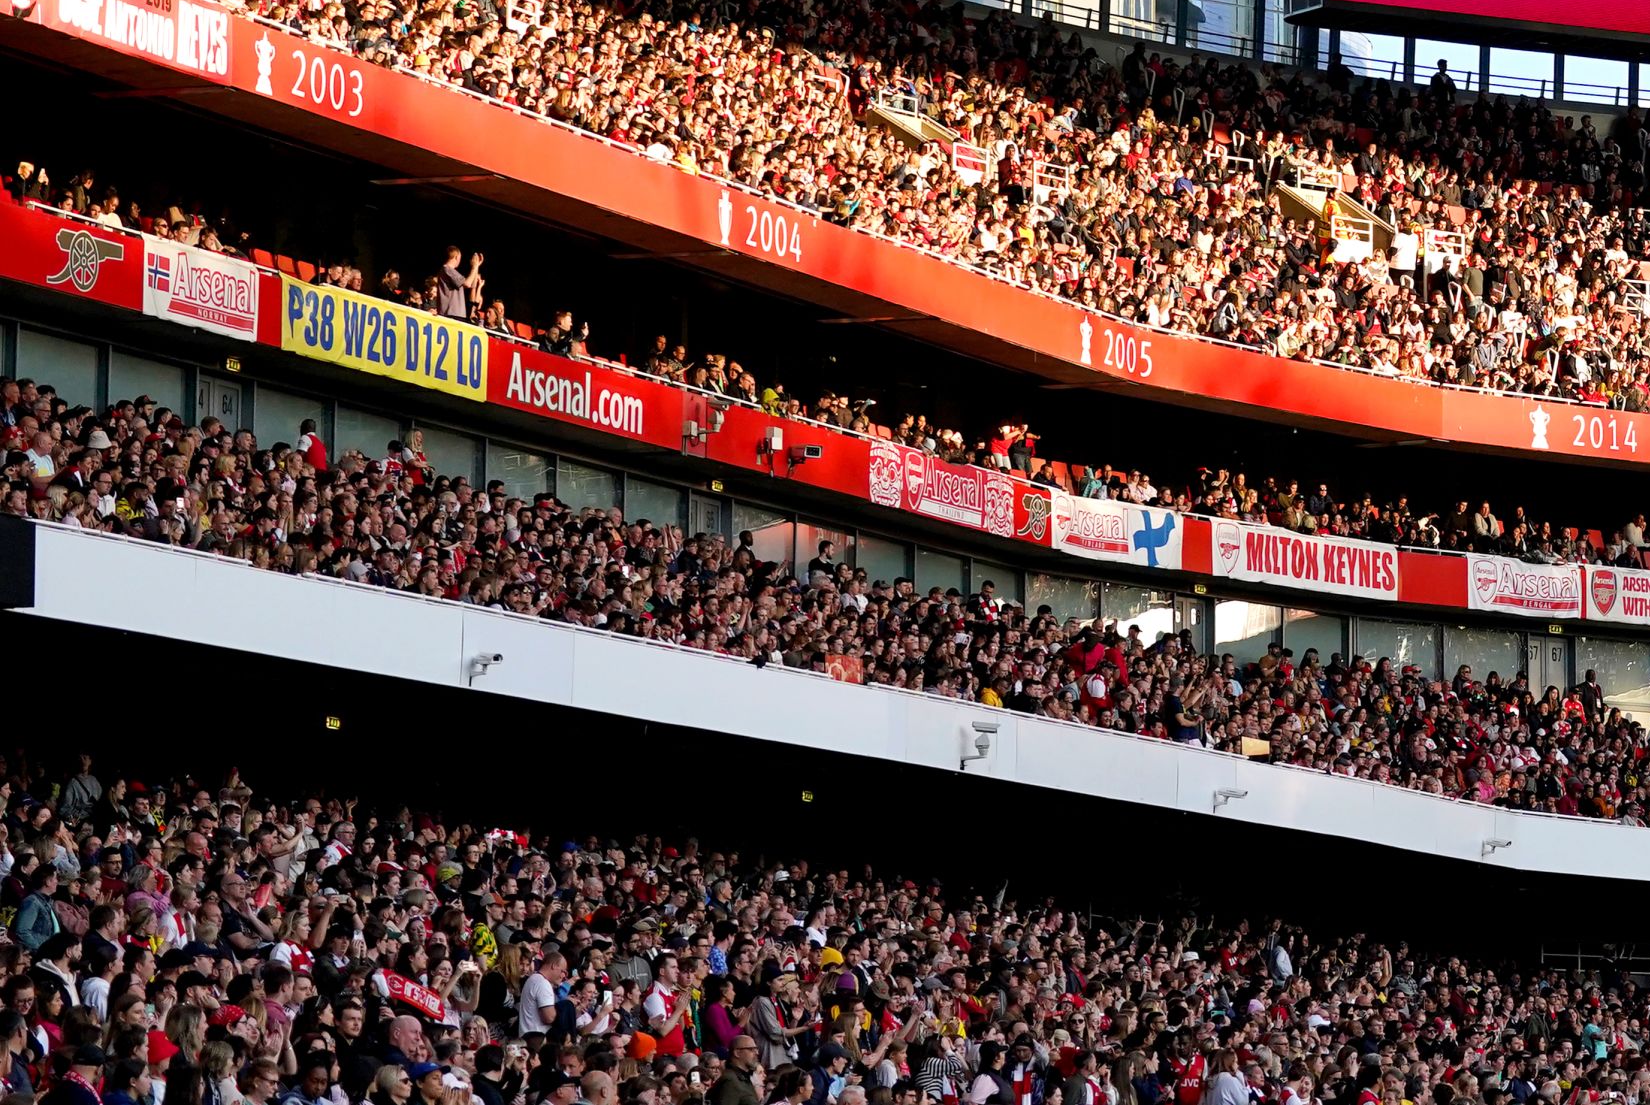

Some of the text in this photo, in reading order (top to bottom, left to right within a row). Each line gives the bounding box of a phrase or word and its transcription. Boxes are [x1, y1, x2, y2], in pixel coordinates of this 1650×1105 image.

[176, 0, 228, 75] REYES
[290, 50, 364, 117] 2003
[745, 205, 803, 263] 2004
[173, 251, 256, 315] Arsenal
[197, 308, 228, 324] NORWAY
[288, 283, 335, 352] P38
[343, 299, 397, 367] W26
[405, 316, 450, 381] D12
[1103, 328, 1153, 377] 2005
[222, 394, 233, 415] 64
[507, 351, 643, 435] Arsenal.com
[1572, 414, 1638, 453] 2014
[923, 456, 983, 510] Arsenal
[1069, 499, 1128, 541] Arsenal
[1245, 531, 1396, 592] MILTON KEYNES
[1498, 563, 1579, 599] Arsenal
[1523, 599, 1552, 609] BENGAL
[1551, 647, 1562, 662] 67
[1181, 1078, 1199, 1088] JVC
